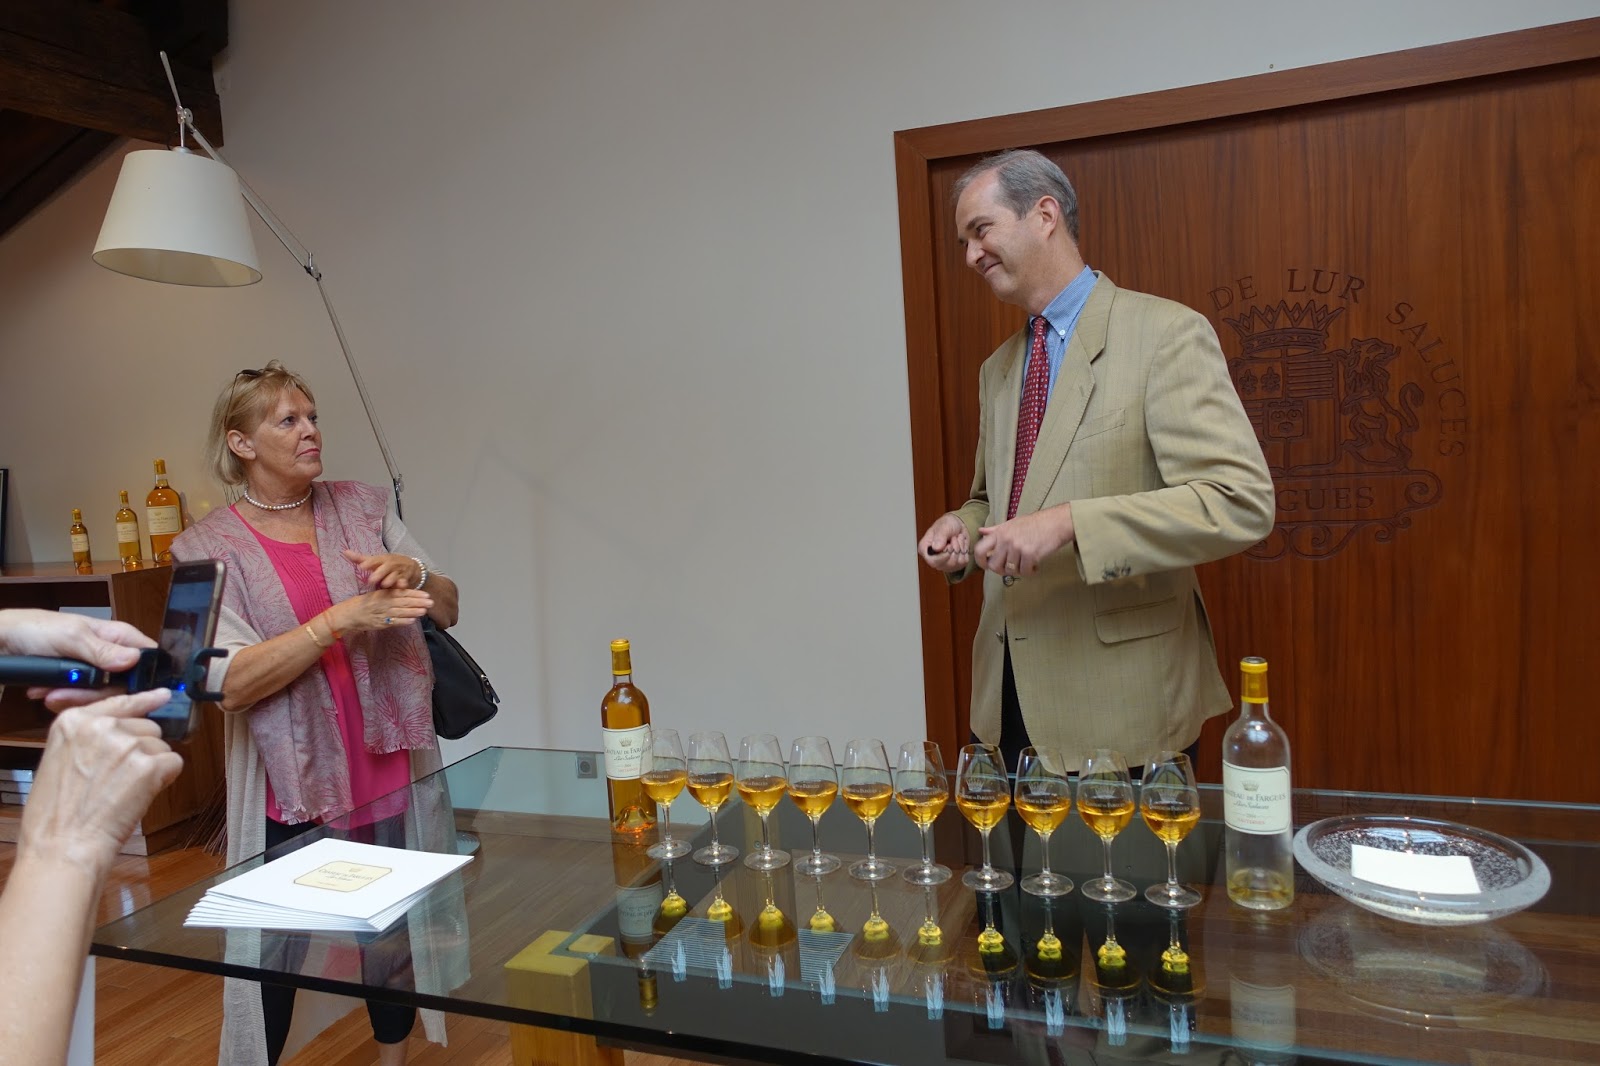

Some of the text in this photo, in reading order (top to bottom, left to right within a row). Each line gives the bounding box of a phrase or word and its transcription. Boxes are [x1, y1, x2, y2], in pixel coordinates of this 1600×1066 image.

[1207, 268, 1468, 457] DE LUR SALUCES
[1275, 486, 1375, 512] GUES
